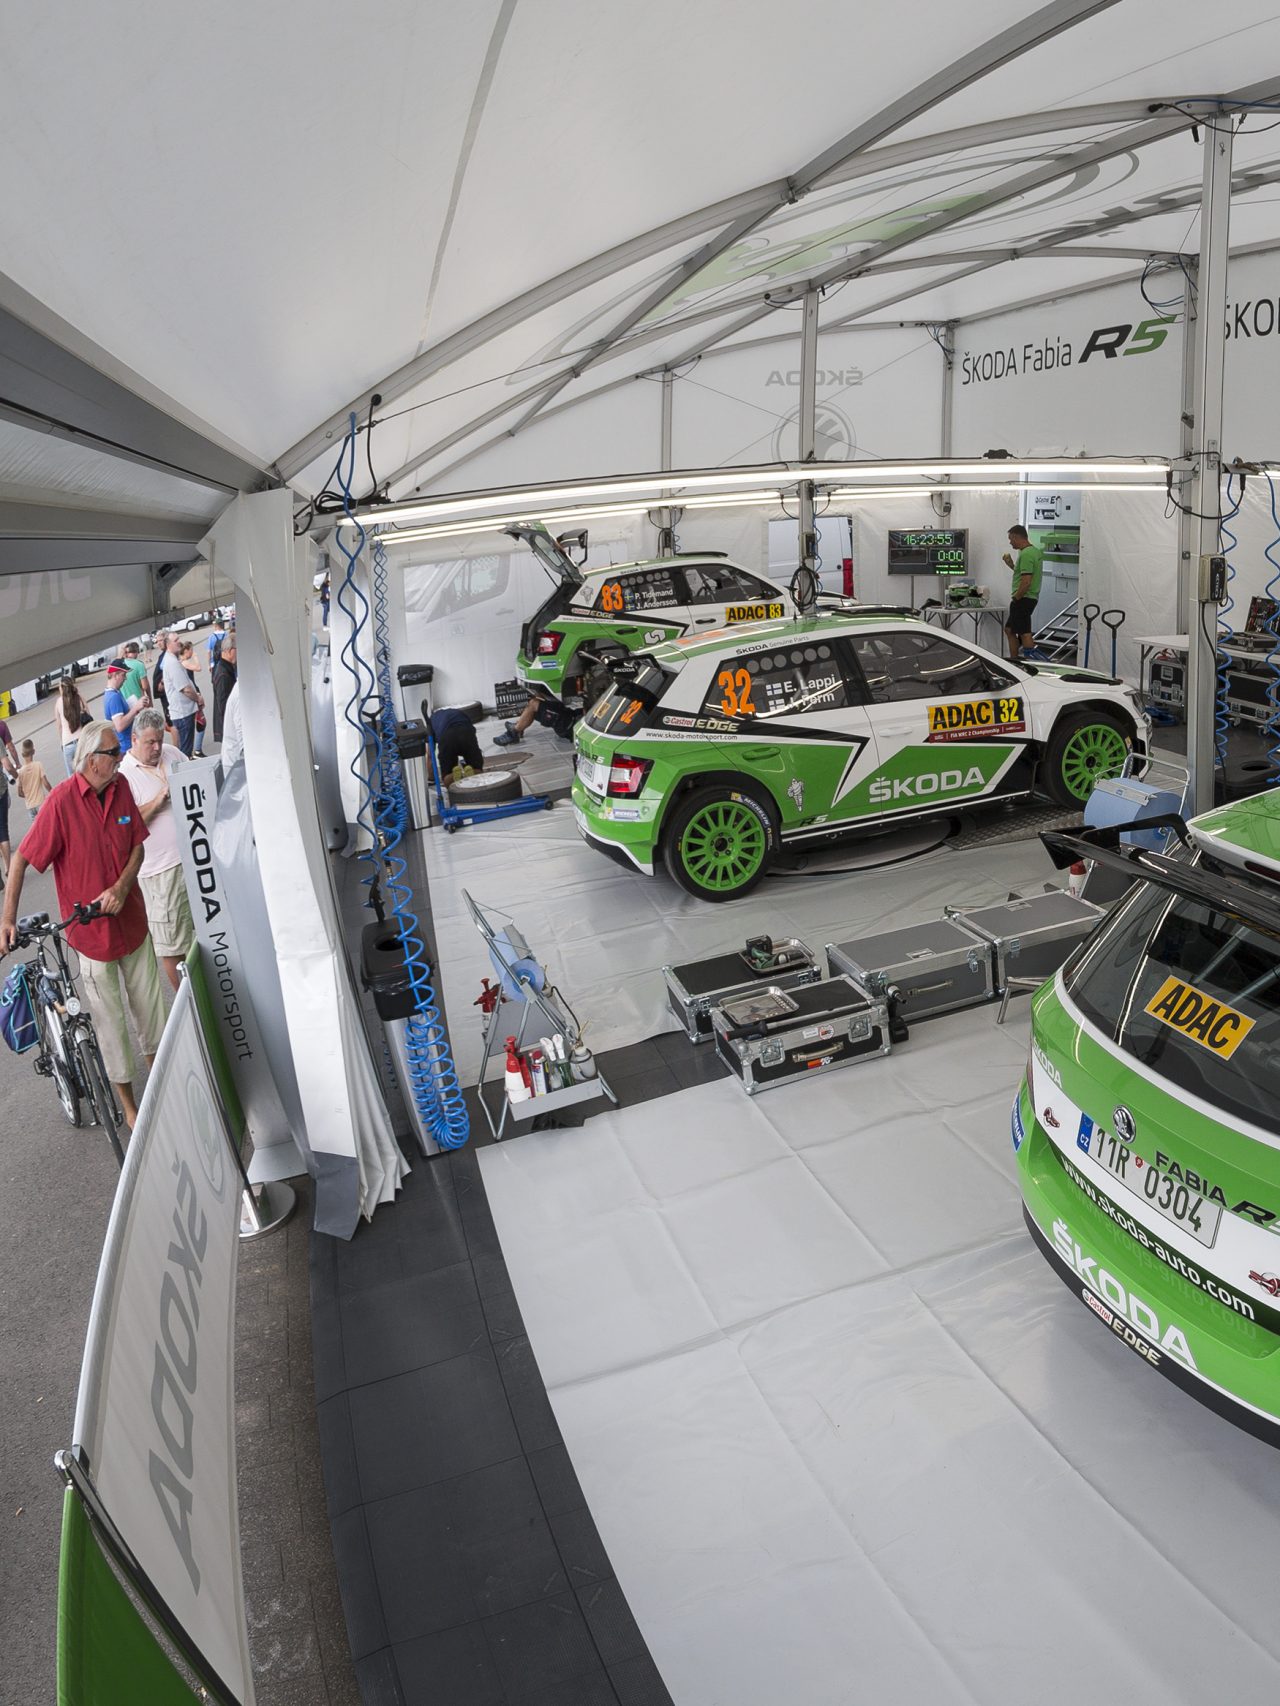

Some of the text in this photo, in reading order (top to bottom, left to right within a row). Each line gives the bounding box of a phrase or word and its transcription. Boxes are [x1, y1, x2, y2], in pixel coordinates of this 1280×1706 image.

[962, 314, 1178, 386] ŠKODA Fabia R5
[903, 533, 953, 546] 16:23:55
[937, 550, 964, 562] 0:00
[601, 583, 624, 612] 83
[636, 598, 678, 610] J. Andersson
[727, 603, 782, 622] ADAC 83
[735, 643, 769, 656] ŠKODA
[718, 668, 756, 717] 32
[783, 674, 836, 693] E. Lappi
[620, 700, 643, 724] 32
[669, 716, 740, 732] Castrol EDGE
[932, 698, 1020, 730] ADAC 32
[646, 731, 738, 742] www.skoda-motorsport.com
[869, 766, 986, 804] ŠKODA
[181, 782, 253, 1061] ŠKODA Motorsport
[1151, 982, 1244, 1051] ADAC
[1079, 1134, 1089, 1148] CZ
[1096, 1127, 1203, 1233] 11R 0304
[1154, 1150, 1228, 1208] FABIA
[1060, 1155, 1256, 1321] www.skoda-auto.com
[1052, 1216, 1199, 1371] ŠKODA
[1087, 1295, 1163, 1366] Castrol EDGE
